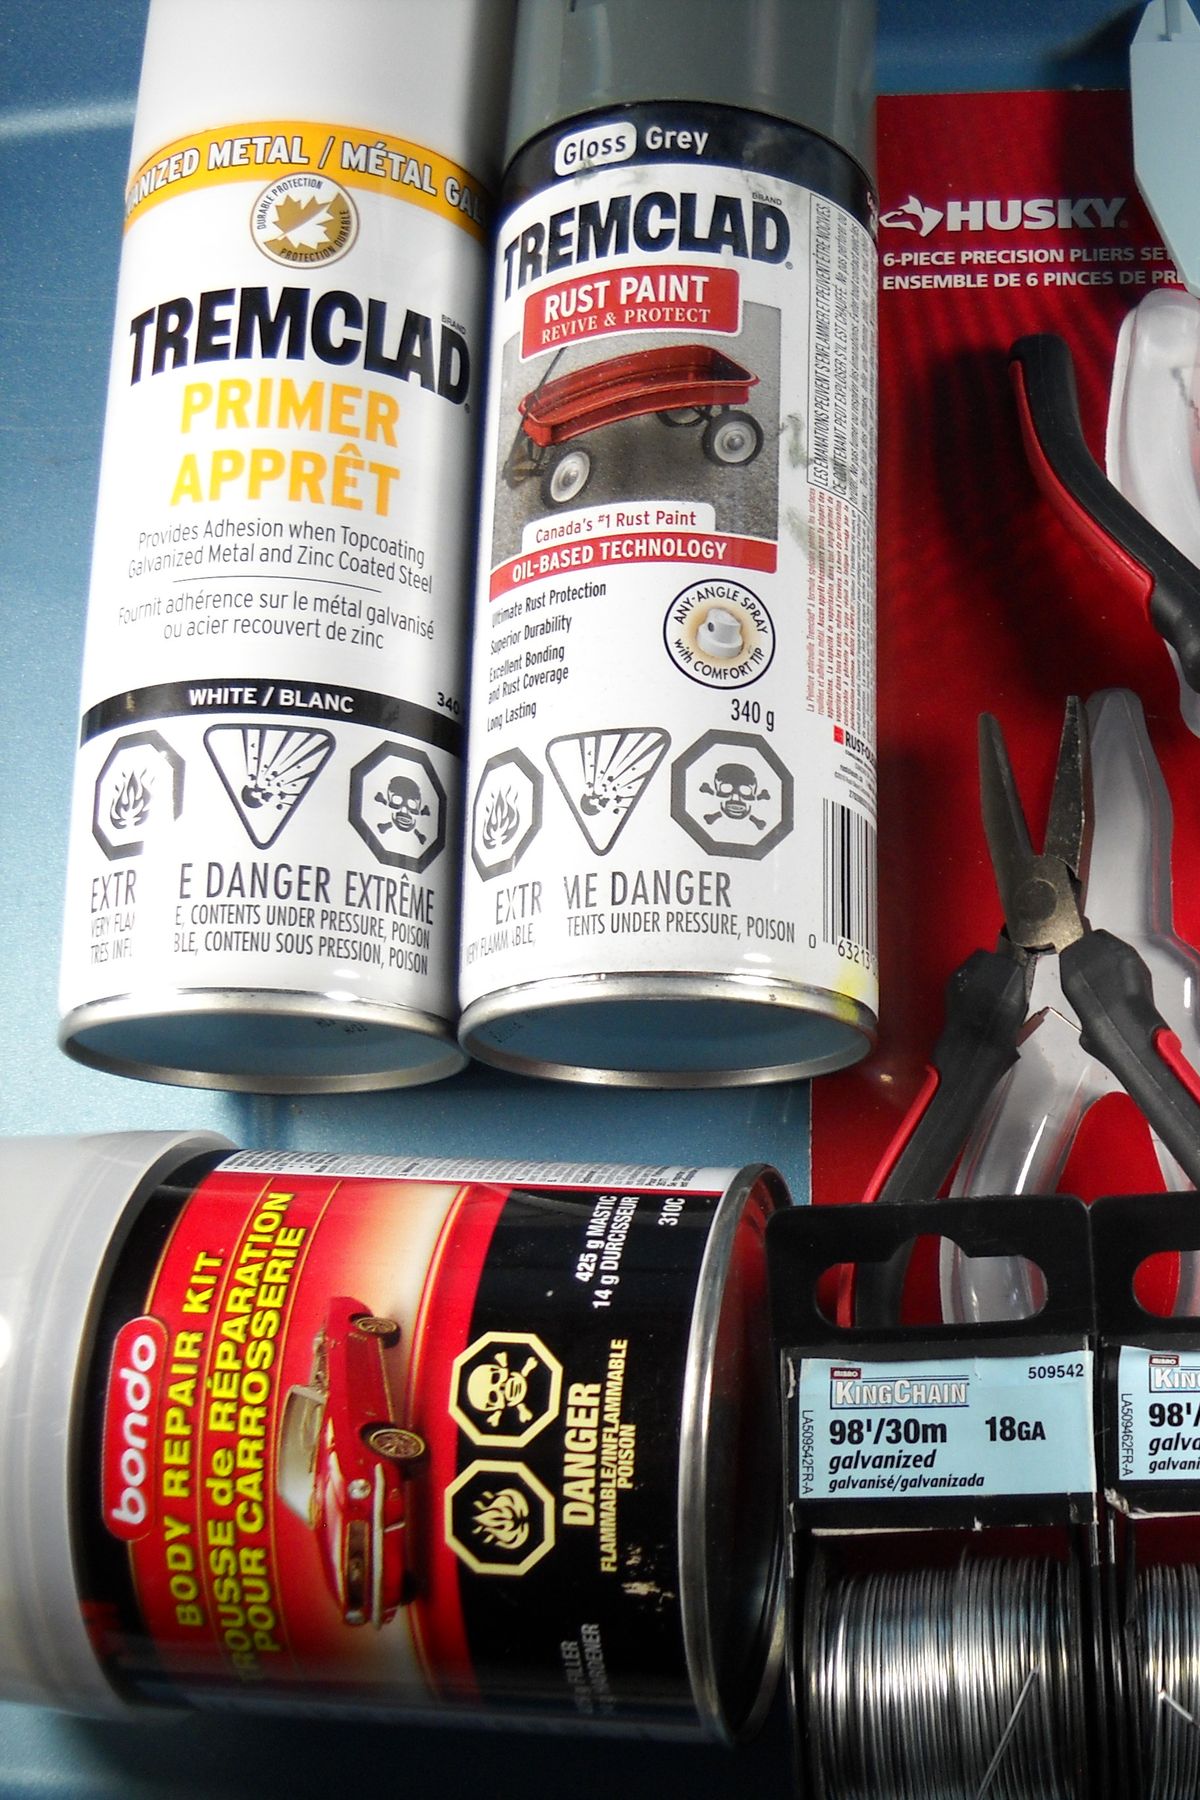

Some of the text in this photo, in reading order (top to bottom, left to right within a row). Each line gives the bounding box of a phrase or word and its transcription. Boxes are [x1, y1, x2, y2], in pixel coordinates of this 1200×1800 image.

[208, 136, 437, 196] METAL MÉTAL
[563, 126, 709, 165] Gloss Grey
[257, 177, 323, 230] DURABLE PROTECTION
[752, 191, 782, 206] BRAND
[947, 198, 1126, 232] HUSKY
[279, 209, 350, 263] PROTECTION DURABLE
[504, 191, 791, 303] TREMCLAD
[883, 248, 1135, 267] 6-PIECE PRECISION PLIERS
[544, 275, 709, 324] RUST PAINT
[882, 274, 988, 290] ENSEMBLE
[994, 273, 1020, 287] DE
[1044, 272, 1113, 286] PINCES
[1119, 271, 1145, 285] DE
[130, 286, 471, 406] TREMCLAD
[441, 314, 466, 336] BRAND
[541, 307, 711, 345] REVIVE PROTECT
[179, 377, 400, 449] PRIMER
[169, 442, 401, 517] APPRÊT
[138, 517, 426, 571] Provides Adhesion when Topcoating
[536, 509, 697, 545] Canada's Rust Paint
[128, 542, 434, 595] Galvanized Metal and Zinc Coated Steel
[512, 538, 728, 583] OIL-BASED TECHNOLOGY
[118, 589, 435, 641] Fournit adhérence sur le métal galvanisé
[525, 581, 607, 613] Rust Protection
[673, 586, 769, 636] ANY-ANGLE SPRAY
[186, 616, 385, 651] acier recouvert de zinc
[490, 614, 573, 655] Superior Durability
[489, 644, 565, 684] Excellent Bonding
[673, 637, 765, 681] with COMFORT TIP
[189, 686, 354, 714] WHITE BLANC
[502, 665, 569, 699] Rust Coverage
[504, 701, 537, 724] Lasting
[730, 699, 762, 723] 340
[206, 861, 435, 926] DANGER EXTRÊME
[611, 870, 732, 908] DANGER
[191, 904, 430, 951] CONTENTS UNDER PRESSURE, POISON
[611, 910, 795, 944] UNDER PRESSURE, POISON
[204, 930, 428, 976] CONTENU SOUS PRESSION, POISON
[604, 1196, 640, 1272] DURCISSEUR
[658, 1198, 686, 1226] 310C
[575, 1195, 618, 1283] 425 MASTIC
[205, 1192, 295, 1507] de RÉPARATION
[1028, 1363, 1084, 1379] 509542
[834, 1379, 967, 1406] KINGCHAIN
[112, 1333, 157, 1525] bondo
[162, 1251, 224, 1627] BODY REPAIR KIT
[235, 1227, 307, 1652] POUR CARROSSERIE
[829, 1416, 1046, 1445] 98'/30m 18GA
[1120, 1393, 1134, 1477] LA509462FR-A
[563, 1382, 602, 1527] DANGER
[600, 1338, 628, 1573] FLAMMABLE/INFLAMMABLE
[617, 1423, 637, 1490] POISON
[801, 1409, 814, 1495] LA509542FR-A
[828, 1449, 937, 1474] galvanized
[828, 1473, 985, 1493] galvanisé/galvanizada
